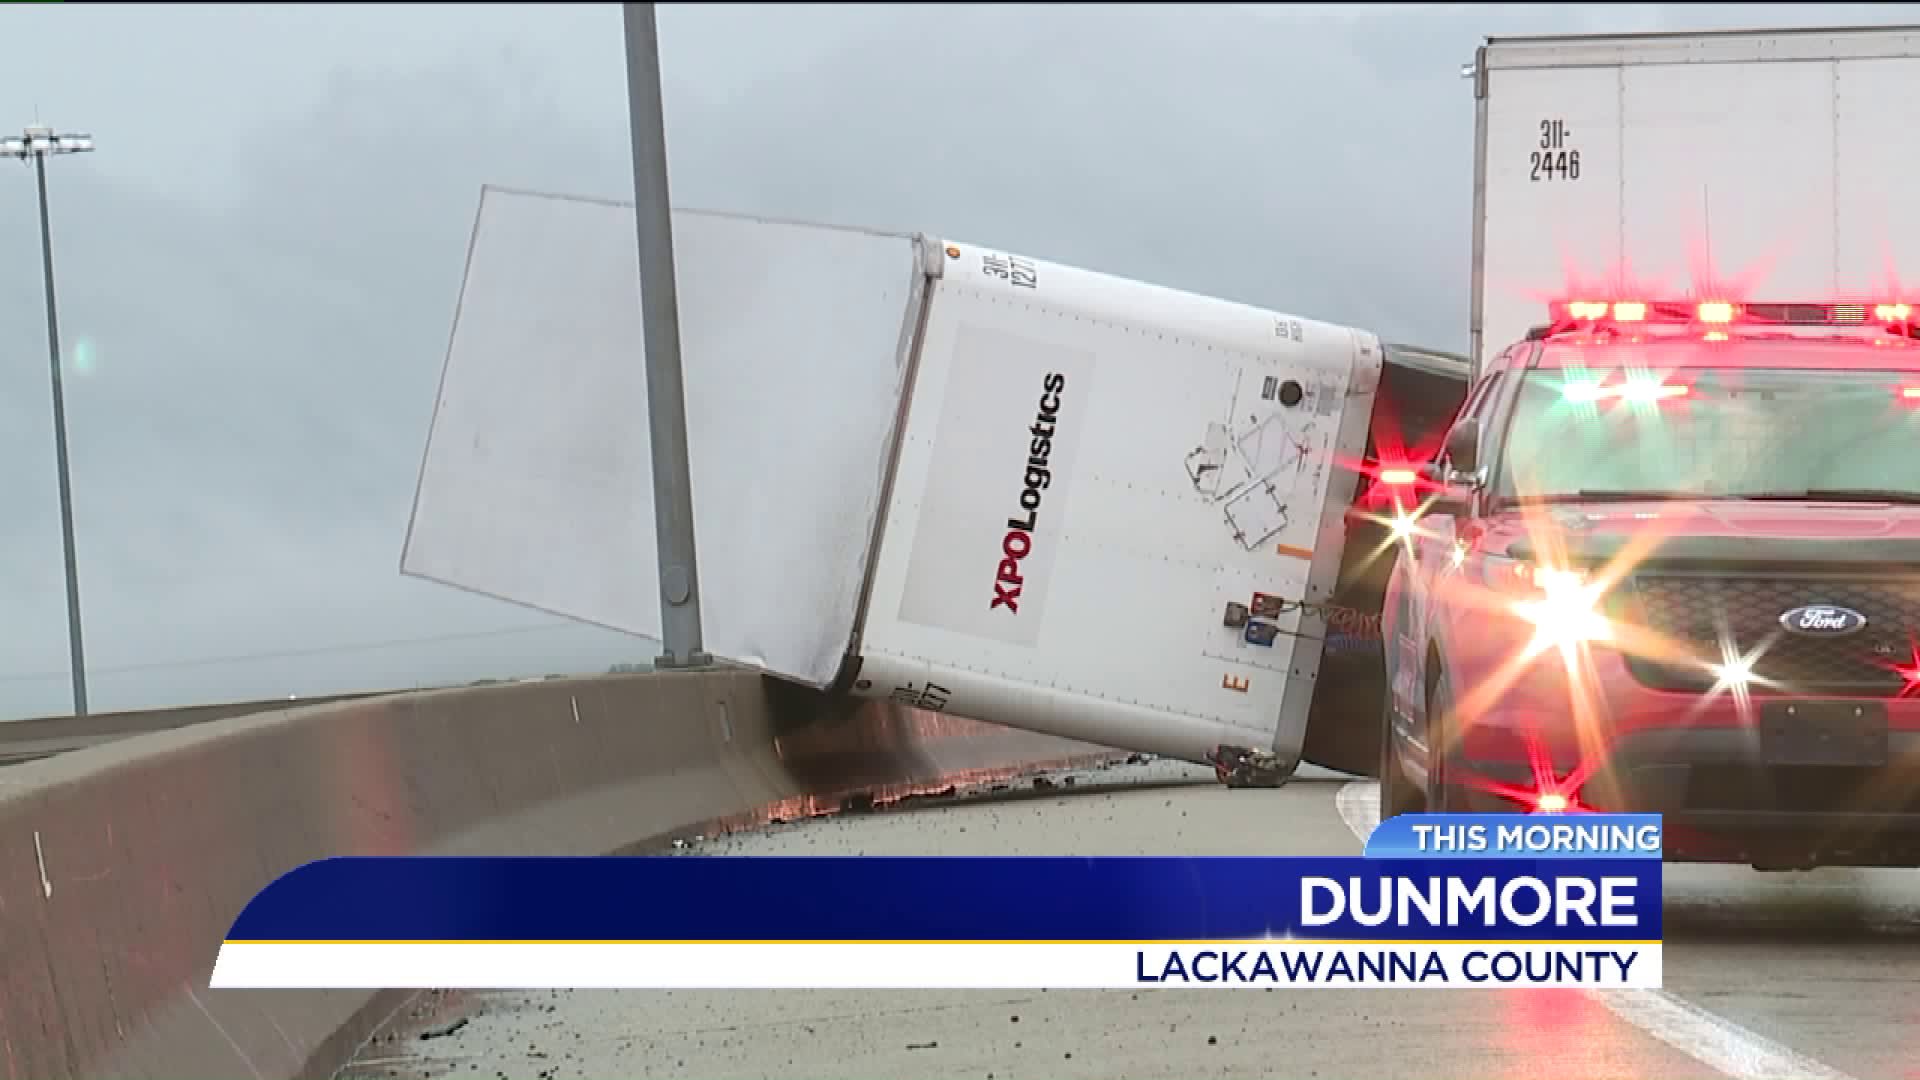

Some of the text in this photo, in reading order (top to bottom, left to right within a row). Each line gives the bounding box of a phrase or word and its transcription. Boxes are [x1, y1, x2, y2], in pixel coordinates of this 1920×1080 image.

[1540, 119, 1570, 149] 311-
[1530, 149, 1580, 181] 2446
[1800, 609, 1846, 629] Ford
